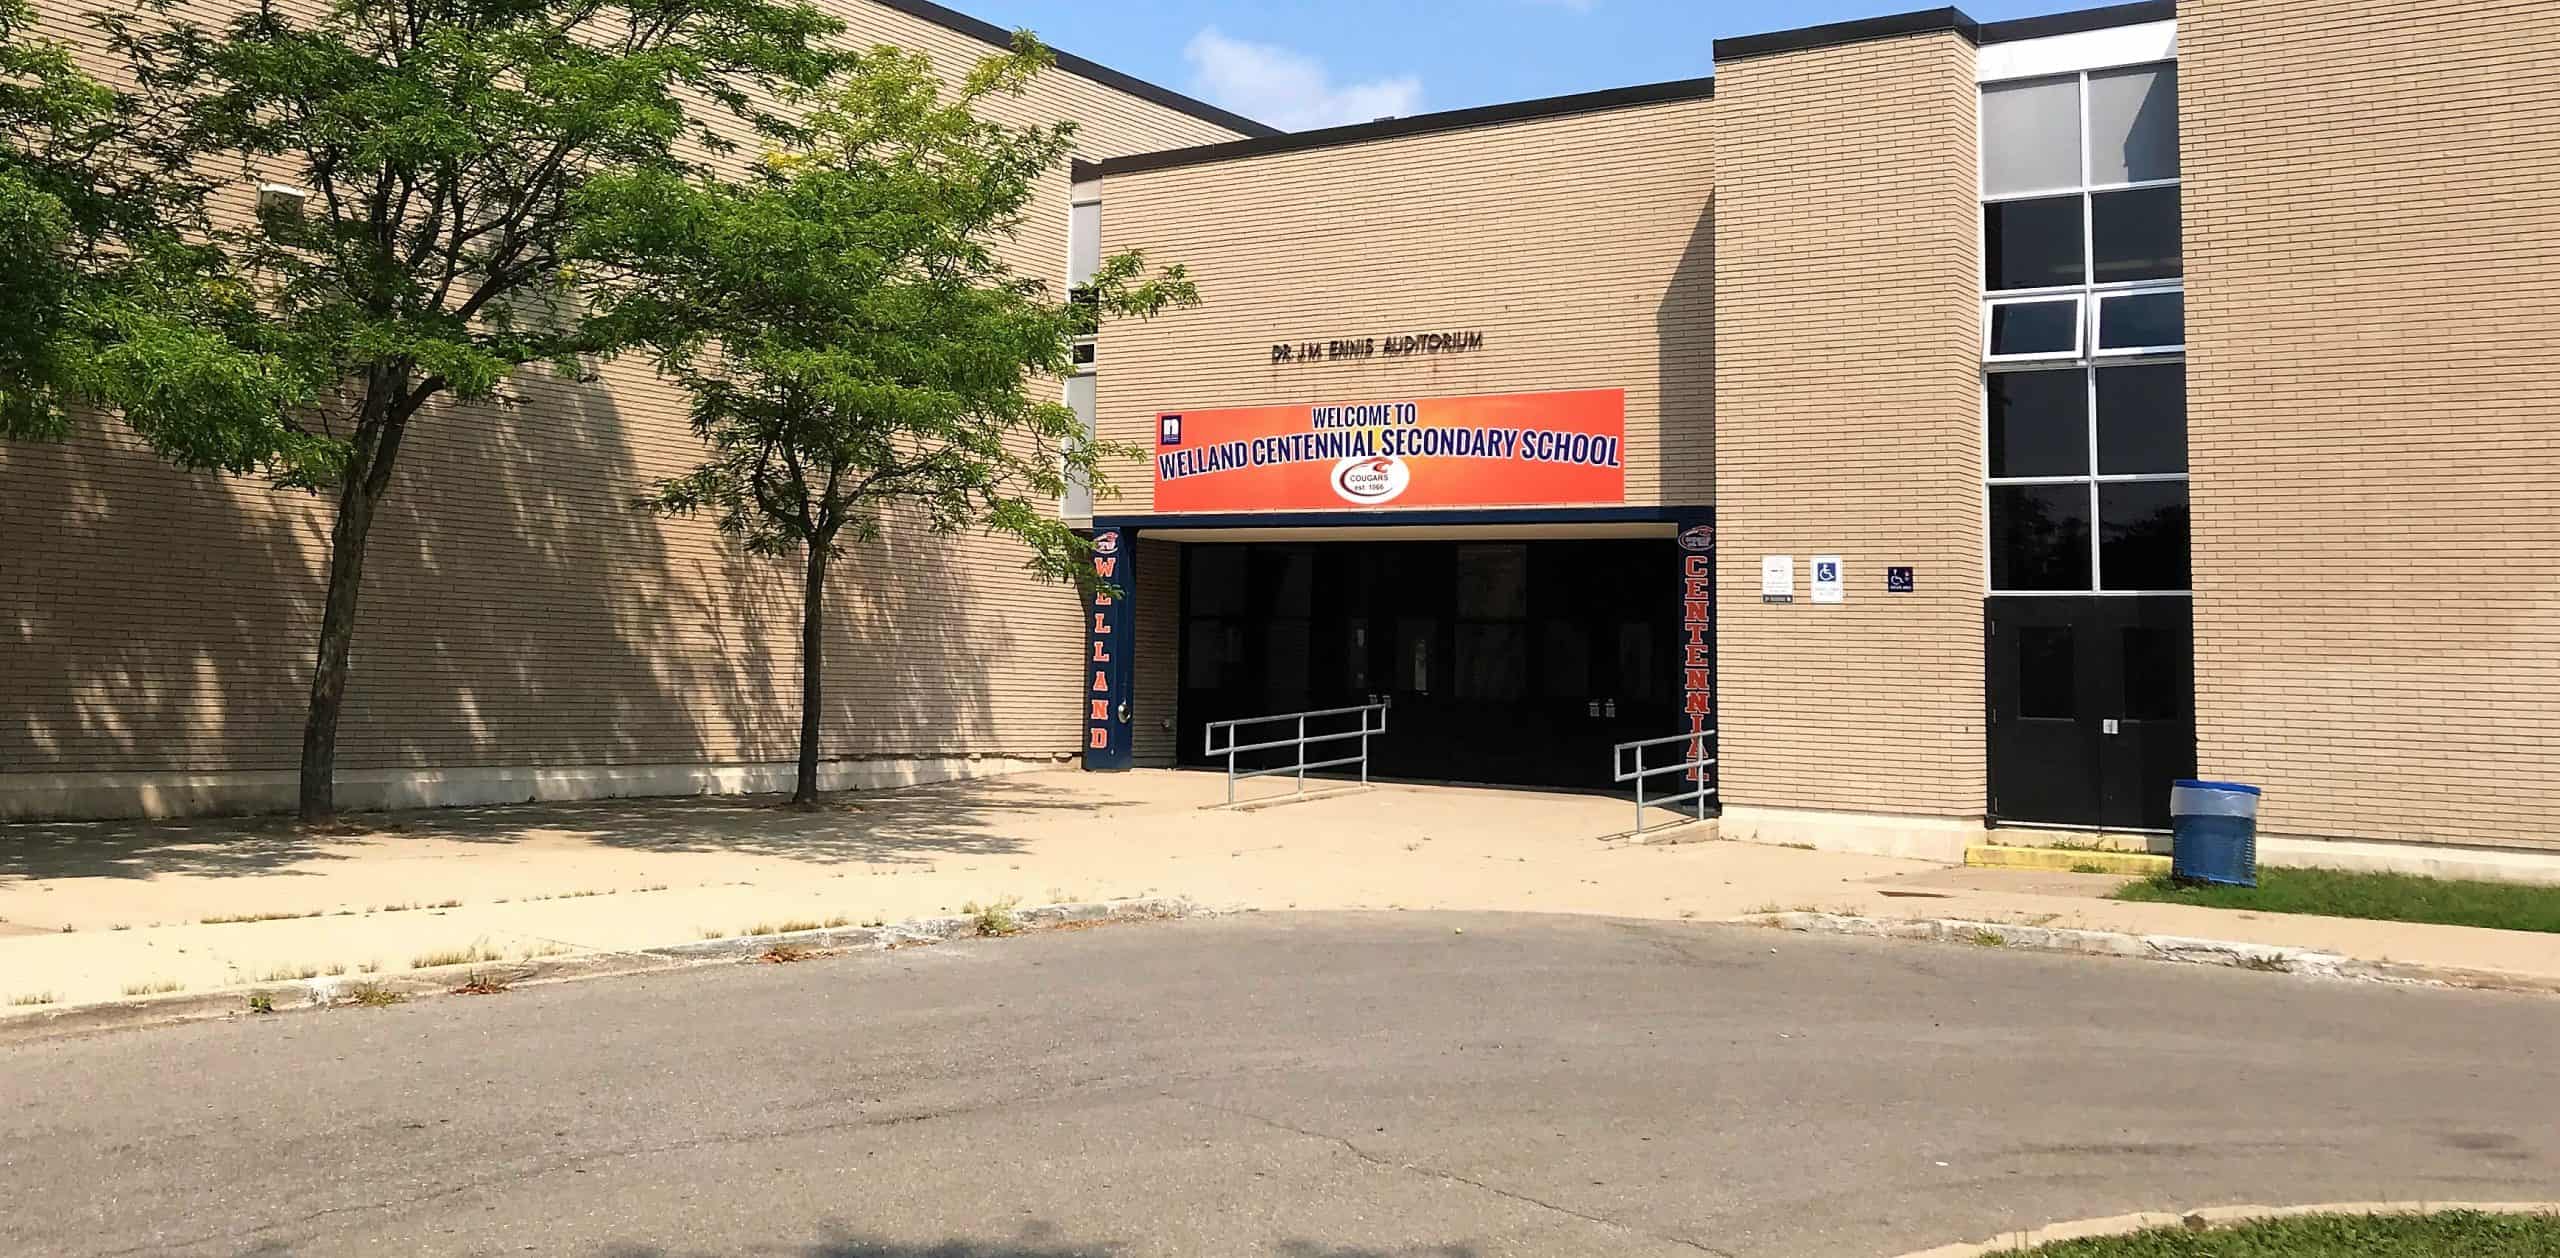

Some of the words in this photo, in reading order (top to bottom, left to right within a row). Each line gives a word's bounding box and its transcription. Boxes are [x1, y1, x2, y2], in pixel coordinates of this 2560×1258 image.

[1329, 338, 1374, 359] ENNIS
[1383, 330, 1483, 355] AUDITORIUM
[1311, 404, 1392, 429] WELCOME
[1395, 403, 1417, 425] TO
[1159, 441, 1248, 480] WELLAND
[1252, 430, 1376, 466] CENTENNIAL
[1381, 427, 1518, 459] SECONDARY
[1521, 430, 1620, 468] SCHOOL
[1350, 474, 1389, 483] COUGARS
